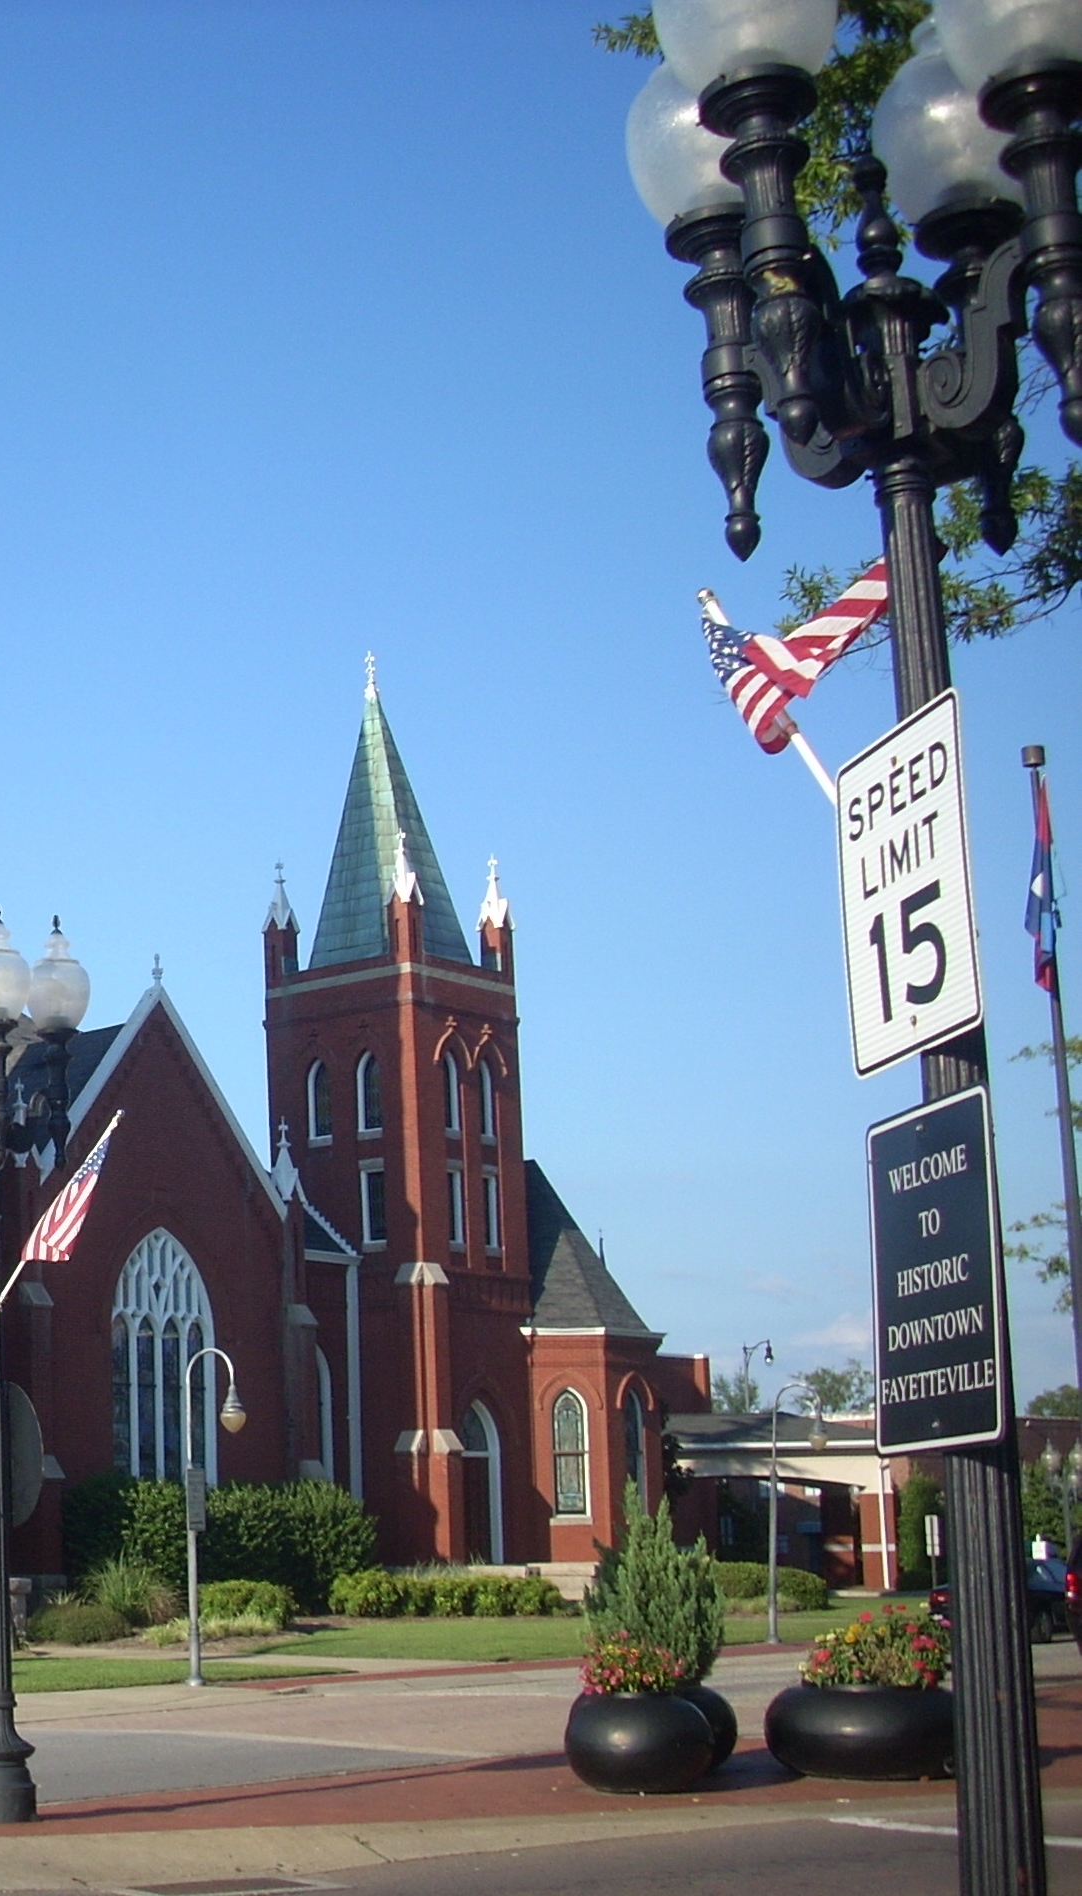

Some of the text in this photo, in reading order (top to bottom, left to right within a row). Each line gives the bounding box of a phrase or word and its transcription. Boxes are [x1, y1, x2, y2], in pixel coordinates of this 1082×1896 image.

[848, 741, 948, 842] SPEED
[861, 810, 938, 900] LIMIT
[869, 878, 947, 1024] 15
[888, 1143, 967, 1194] WELCOME
[918, 1207, 941, 1238] TO
[897, 1253, 969, 1298] HISTORIC
[888, 1304, 983, 1352] DOWNTOWN
[881, 1358, 994, 1405] FAYETTEVILLE
